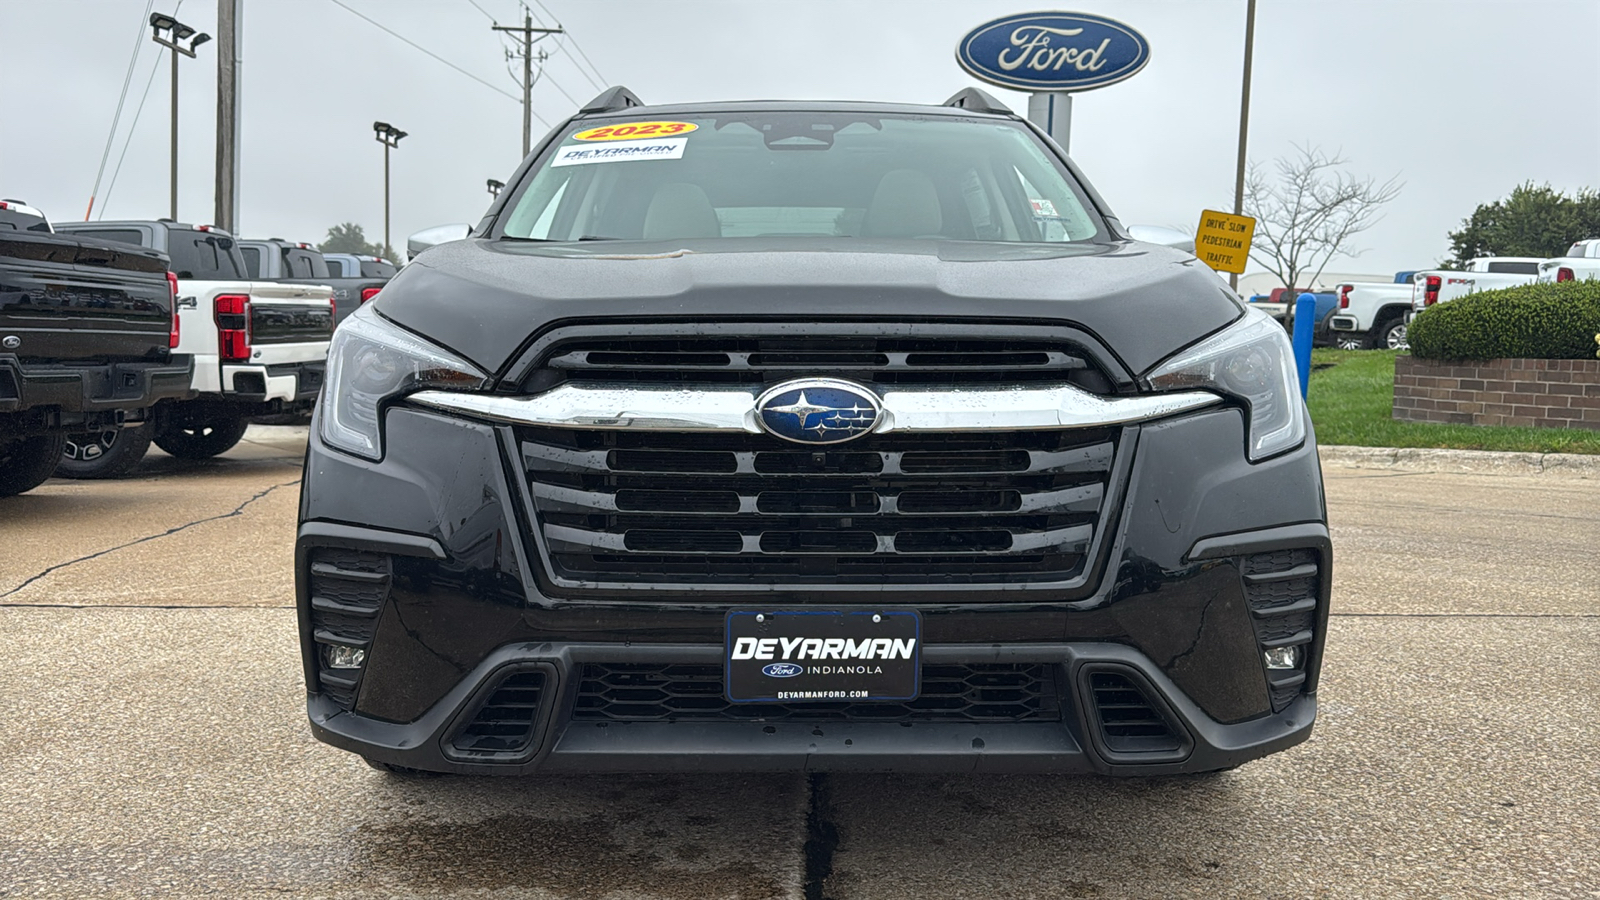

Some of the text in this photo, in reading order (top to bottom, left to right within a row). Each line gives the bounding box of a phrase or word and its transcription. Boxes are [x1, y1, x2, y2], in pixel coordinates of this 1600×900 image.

[998, 25, 1111, 71] Ford
[585, 123, 687, 139] 2023
[563, 145, 678, 159] DEYARMAN
[1206, 218, 1246, 233] DRIVE SLOW
[1202, 234, 1242, 249] PEDESTRIAN
[1206, 252, 1233, 265] TRAFFIC
[731, 637, 916, 660] DEYARMAN
[807, 665, 882, 674] INDIANOLA
[777, 690, 869, 699] DEYARMANFORD.COM
